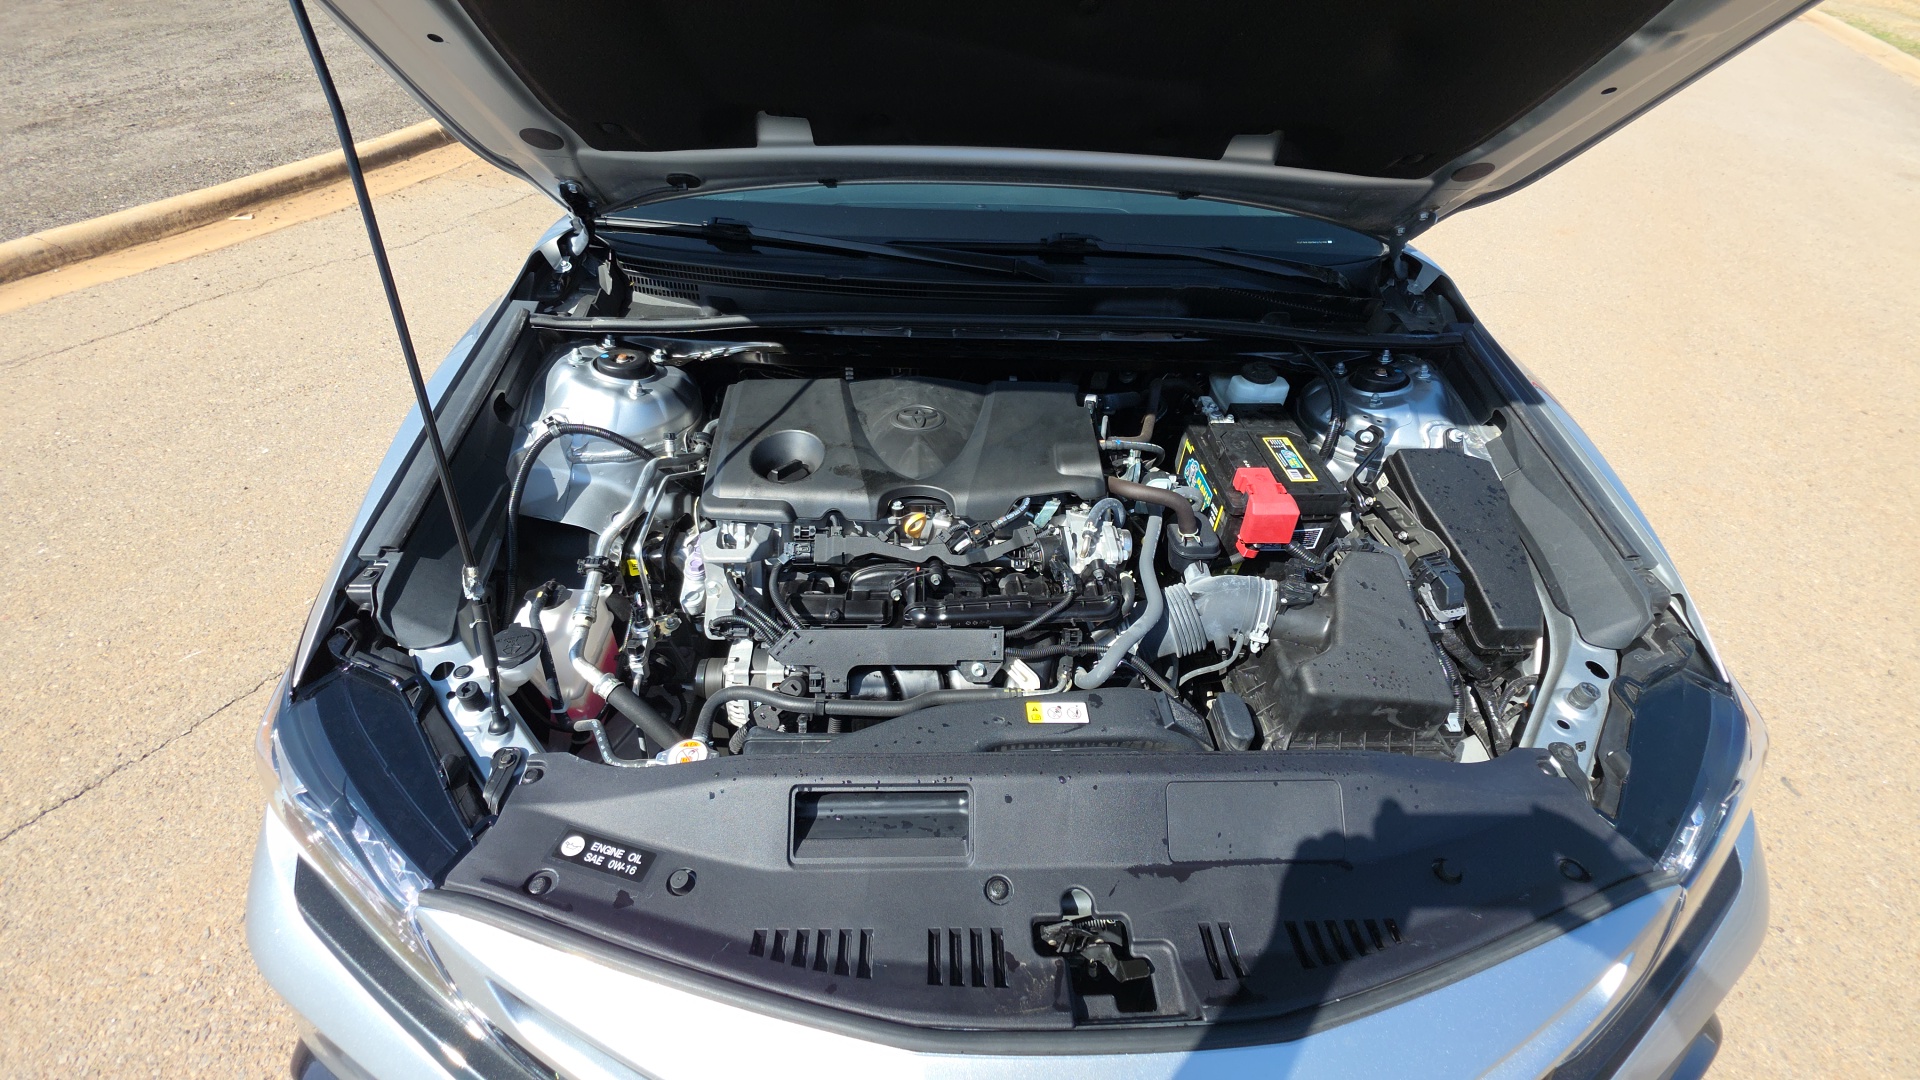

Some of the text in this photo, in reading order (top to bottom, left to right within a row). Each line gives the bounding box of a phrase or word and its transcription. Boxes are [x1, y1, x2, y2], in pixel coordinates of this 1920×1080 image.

[583, 852, 638, 875] SAE 0W-16
[591, 842, 642, 865] ENGINE OIL
